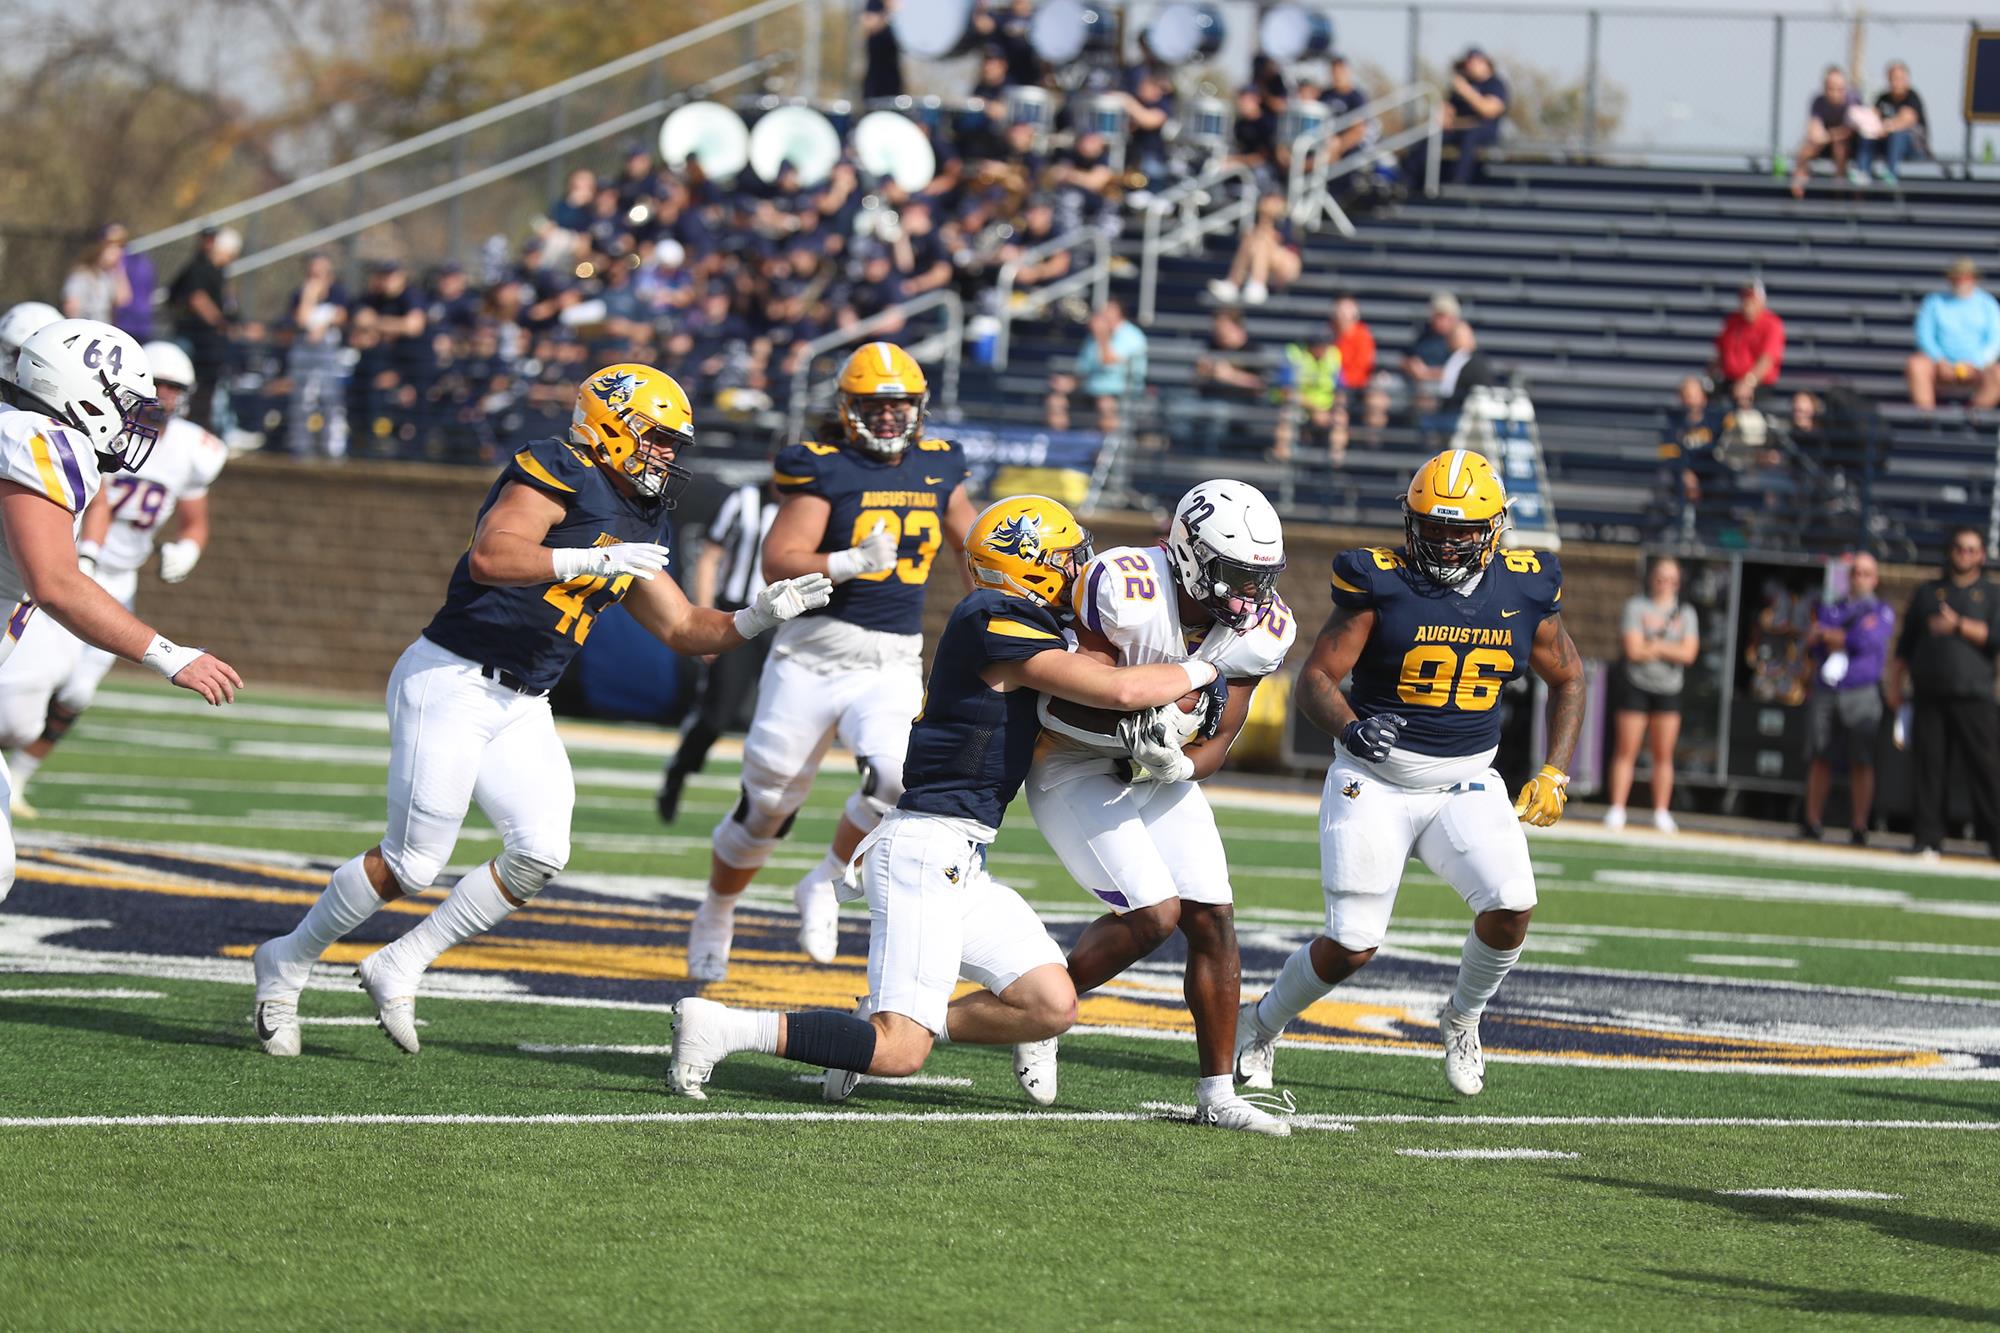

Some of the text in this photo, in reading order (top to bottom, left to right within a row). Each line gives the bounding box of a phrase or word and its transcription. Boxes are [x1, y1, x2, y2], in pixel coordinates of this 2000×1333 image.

[83, 339, 123, 376] 64
[109, 477, 167, 530] 79
[860, 490, 938, 508] AUGUSTANA
[1180, 495, 1215, 532] 22
[1114, 554, 1156, 603] 22
[1414, 625, 1513, 646] AUGUSTANA
[1397, 644, 1515, 712] 96
